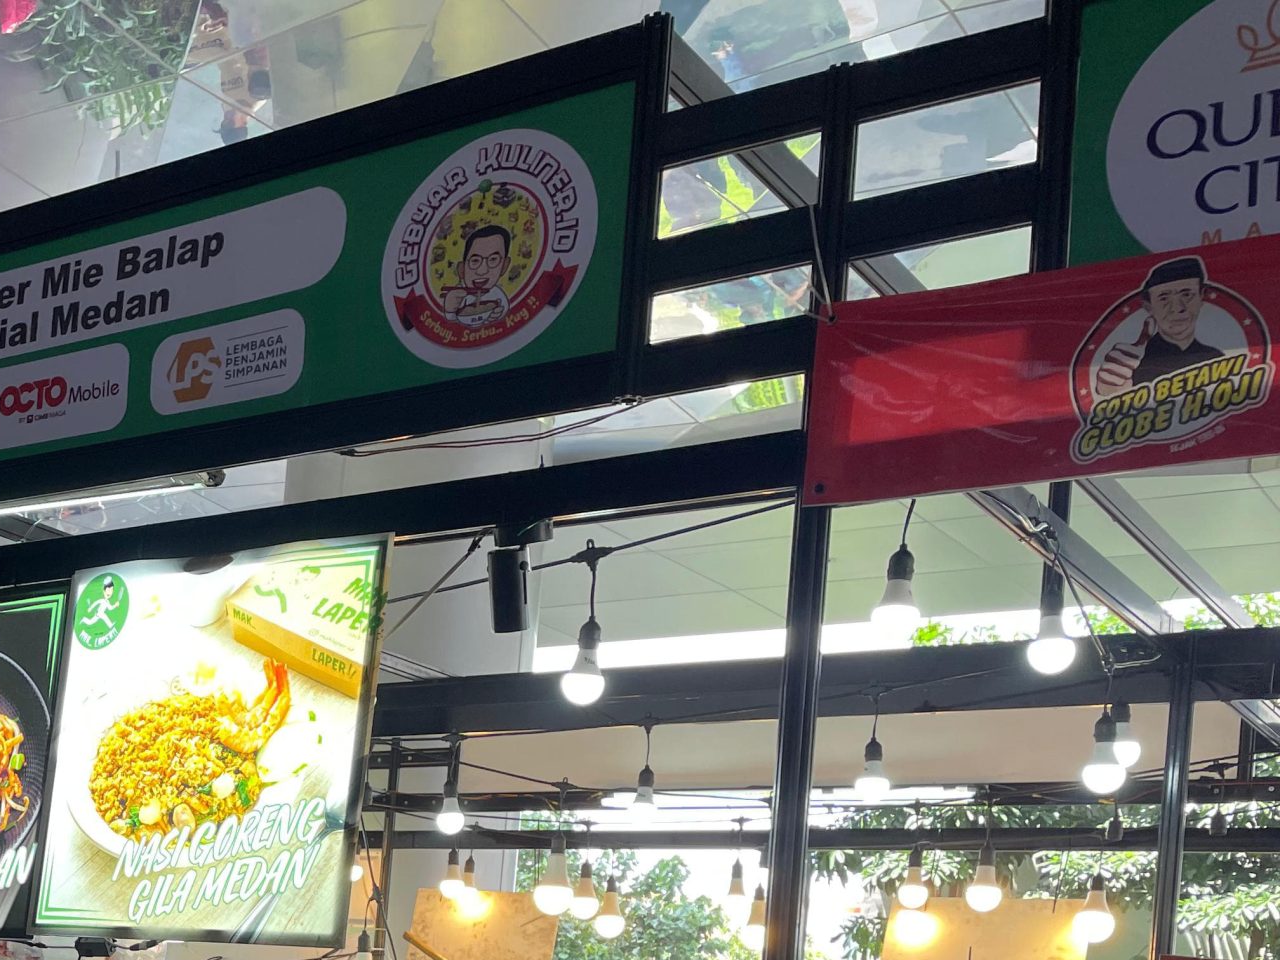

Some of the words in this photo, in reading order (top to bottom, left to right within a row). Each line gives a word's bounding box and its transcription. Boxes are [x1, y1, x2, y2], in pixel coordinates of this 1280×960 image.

[1147, 89, 1280, 159] QU
[395, 166, 468, 289] GEBYAR
[42, 259, 104, 298] Mie
[117, 230, 224, 280] Balap
[50, 288, 170, 337] Medan
[226, 334, 283, 356] LEMBAGA
[224, 358, 287, 380] SIMPANAN
[225, 345, 287, 368] PENJAMIN
[1092, 384, 1148, 423] SOTO
[1154, 353, 1246, 403] BETAWI
[68, 379, 120, 405] Mobile
[1080, 402, 1173, 458] GLOBE
[1179, 370, 1267, 429] H.OJI
[112, 832, 186, 883] NASI
[187, 797, 327, 857] GORENG
[129, 872, 201, 923] GILA
[197, 841, 321, 902] MEDAN
